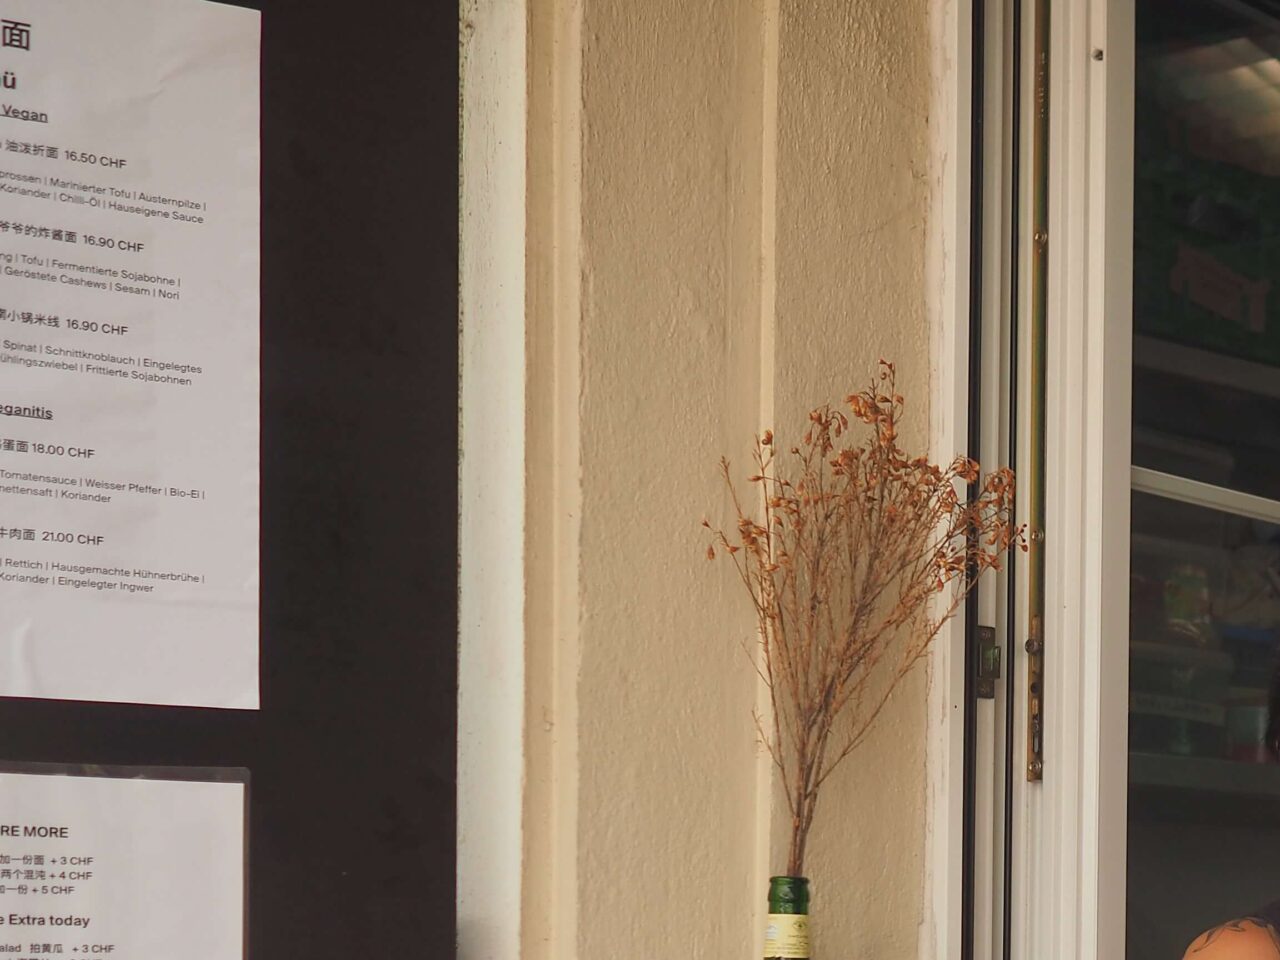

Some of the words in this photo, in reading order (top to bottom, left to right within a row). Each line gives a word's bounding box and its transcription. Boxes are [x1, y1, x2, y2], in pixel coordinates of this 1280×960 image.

[1, 18, 32, 51] 面
[2, 103, 48, 123] Vegan
[64, 149, 97, 165] 16.50
[100, 155, 127, 169] CHF
[0, 183, 50, 200] Koriander
[108, 200, 170, 218] Hauseigene
[172, 210, 204, 224] Sauce
[50, 177, 107, 195] Marinierter
[109, 187, 131, 199] Tofu
[138, 192, 202, 211] Austernpilze
[82, 234, 115, 249] 16.90
[117, 240, 145, 253] CHF
[20, 254, 44, 267] Tofu
[52, 258, 119, 278] Fermentierte
[120, 269, 176, 286] Sojabohne
[60, 274, 107, 290] Cashews
[114, 282, 151, 296] Sesam
[158, 288, 180, 301] Nori
[66, 318, 99, 333] 16.90
[101, 323, 129, 336] CHF
[3, 339, 37, 353] Spinat
[45, 345, 136, 366] Schnittknoblauch
[143, 357, 203, 375] Eingelegtes
[86, 364, 129, 379] Frittierte
[131, 370, 193, 386] Sojabohnen
[31, 443, 65, 457] 18.00
[67, 447, 96, 459] CHF
[0, 468, 78, 486] Tomatensauce
[85, 478, 126, 491] Weisser
[128, 482, 163, 495] Pfeffer
[169, 487, 201, 499] Bio-Ei
[61, 489, 112, 503] Koriander
[41, 530, 74, 544] 21.00
[77, 533, 105, 546] CHF
[4, 557, 43, 570] Rettich
[51, 561, 131, 577] Hausgemachte
[132, 568, 200, 583] Hühnerbrühe
[58, 575, 118, 591] Eingelegter
[120, 580, 155, 593] Ingwer
[23, 825, 69, 839] MORE
[69, 856, 94, 866] CHF
[68, 871, 93, 881] CHF
[50, 885, 75, 895] CHF
[8, 913, 46, 926] Extra
[49, 915, 91, 929] today
[91, 944, 115, 954] CHF
